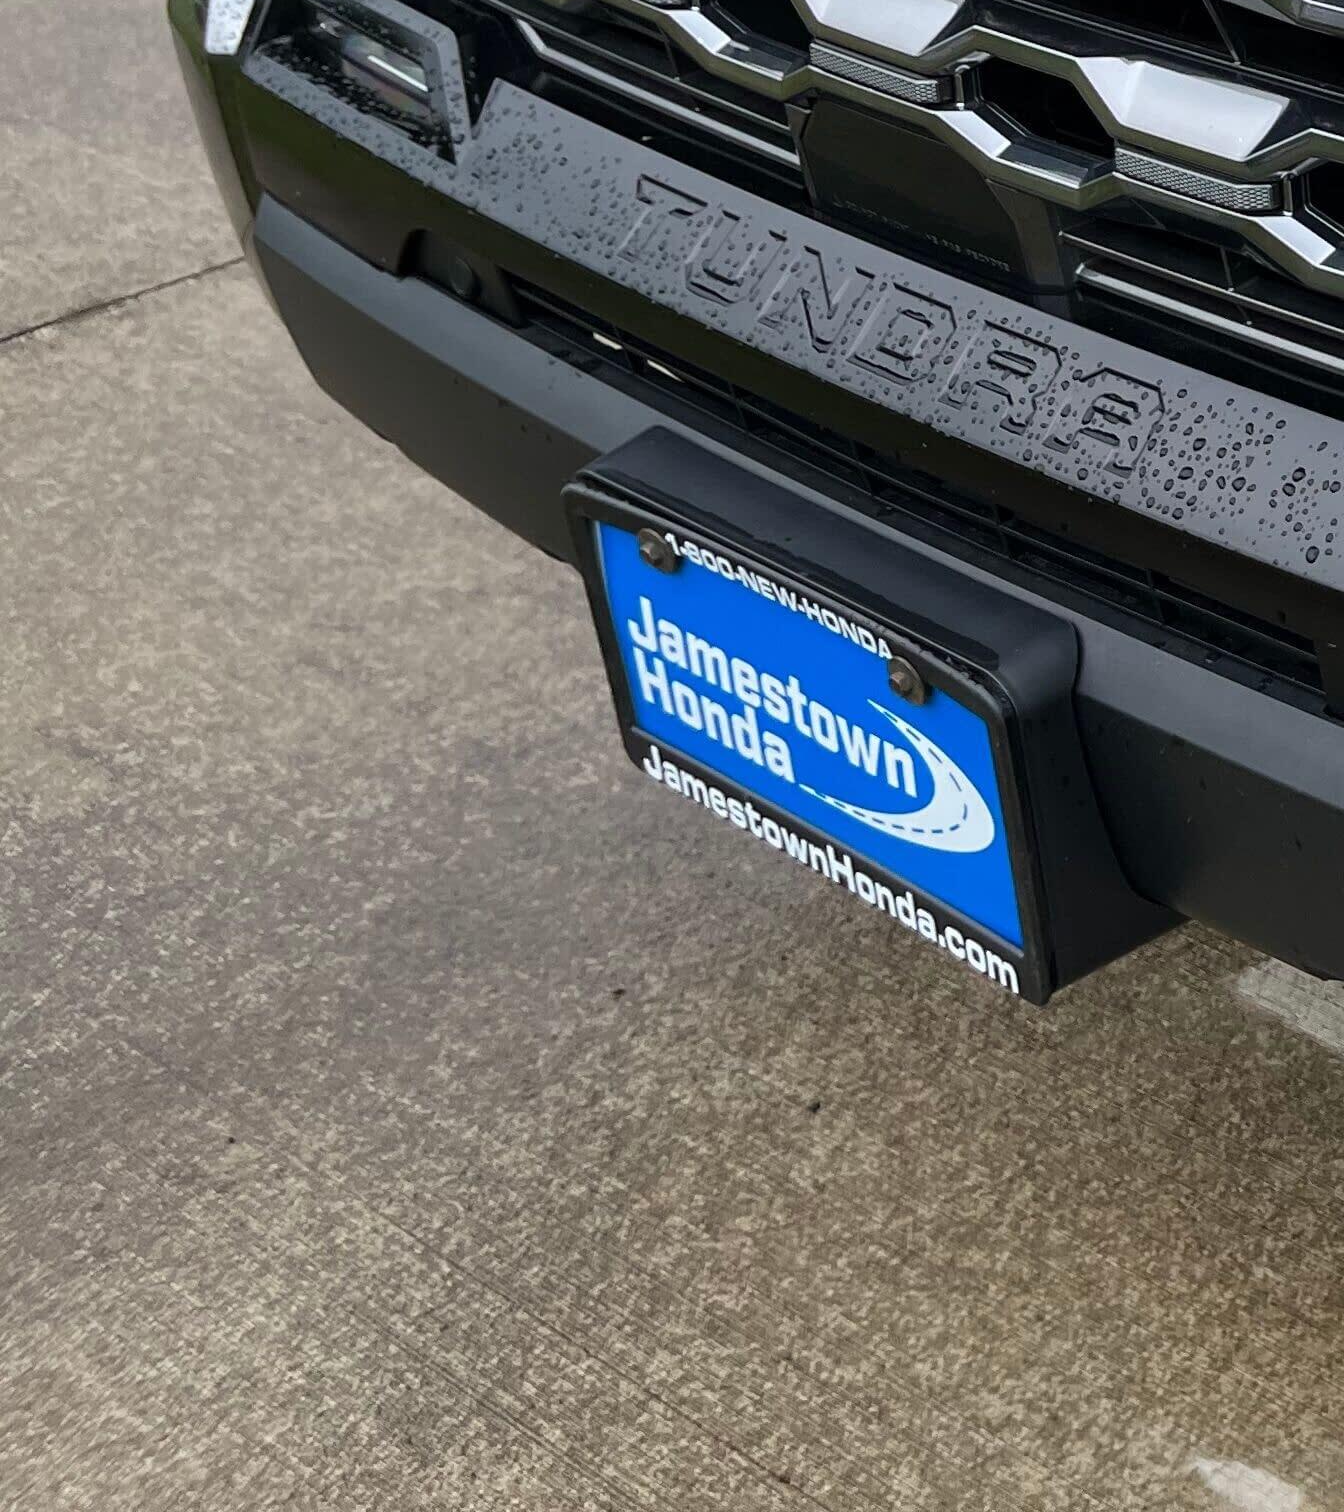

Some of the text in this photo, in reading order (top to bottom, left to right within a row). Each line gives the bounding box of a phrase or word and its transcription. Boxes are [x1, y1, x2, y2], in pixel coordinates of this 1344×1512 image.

[616, 173, 1166, 479] TUNDRA
[628, 595, 918, 798] Jamestown
[665, 532, 894, 660] 1-800-NEW-HONDA
[633, 646, 795, 784] Honda
[643, 745, 1020, 995] JamestownHonda.com
